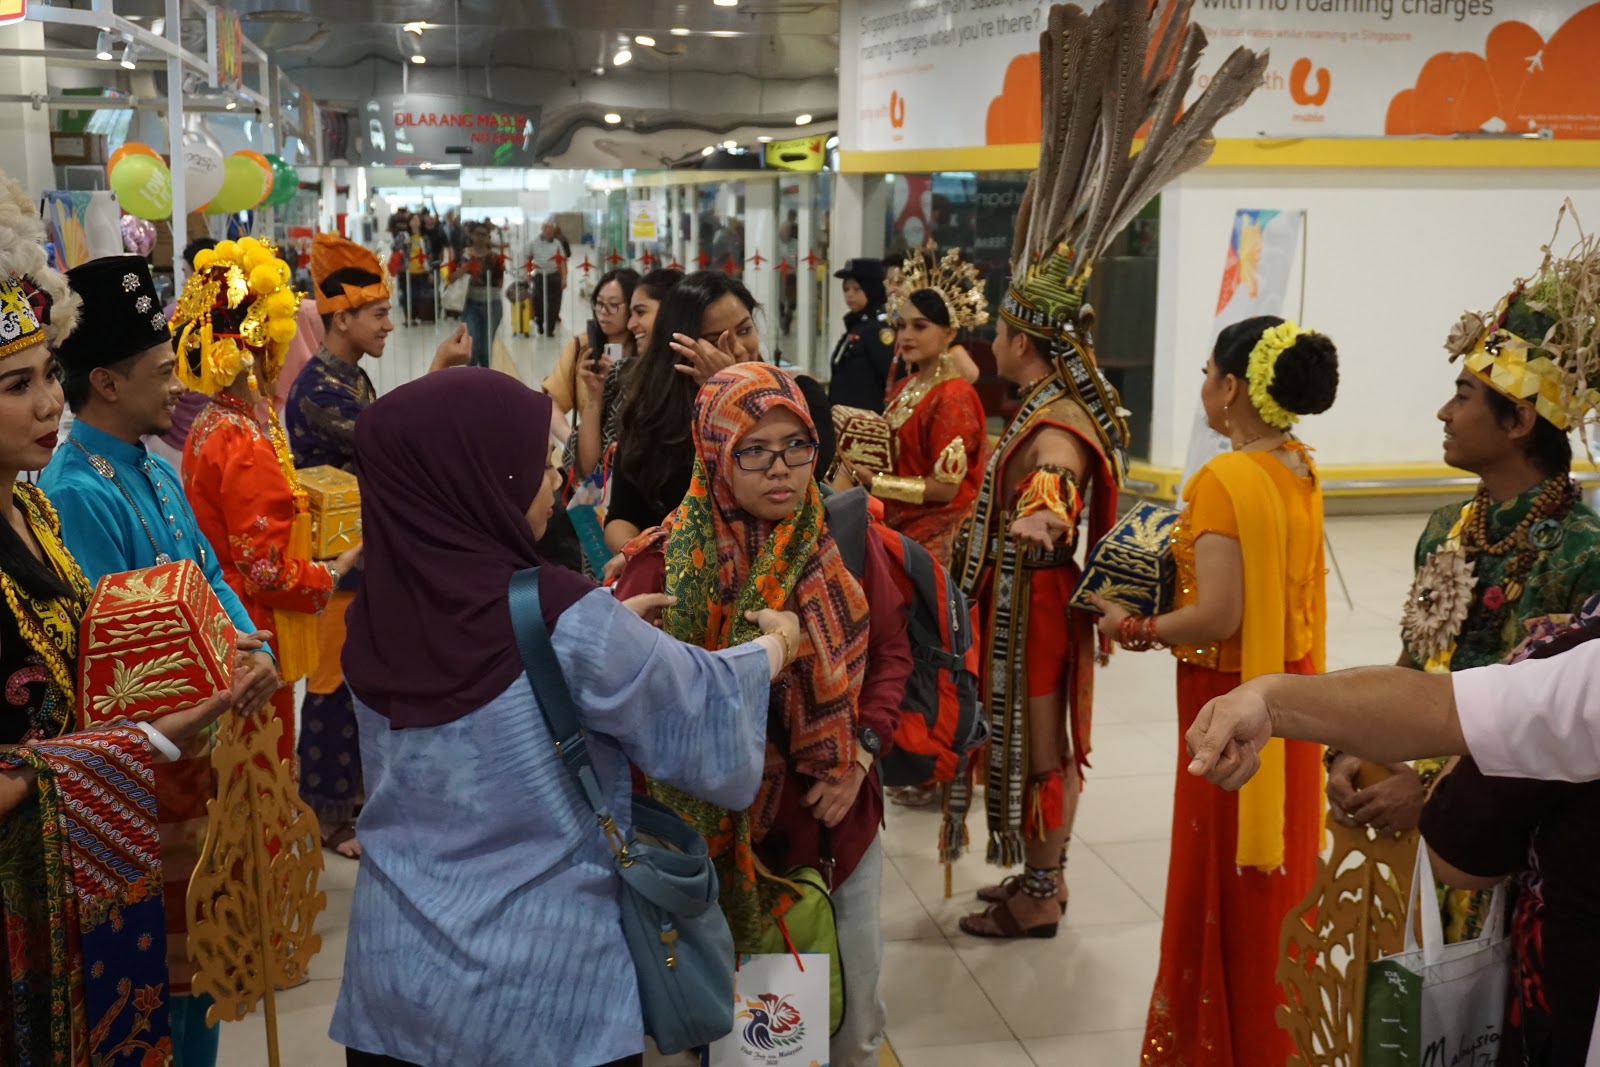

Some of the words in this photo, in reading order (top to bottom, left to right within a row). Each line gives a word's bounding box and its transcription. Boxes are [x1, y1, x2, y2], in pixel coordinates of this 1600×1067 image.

[1259, 0, 1288, 11] no
[1295, 0, 1393, 20] roaming
[1401, 0, 1494, 22] charges
[958, 18, 993, 47] you're
[995, 8, 1041, 34] there?
[1276, 28, 1302, 39] while
[1304, 30, 1347, 43] roaming
[1349, 30, 1359, 40] in
[1361, 29, 1413, 44] Singapore
[394, 112, 473, 128] DILARANG
